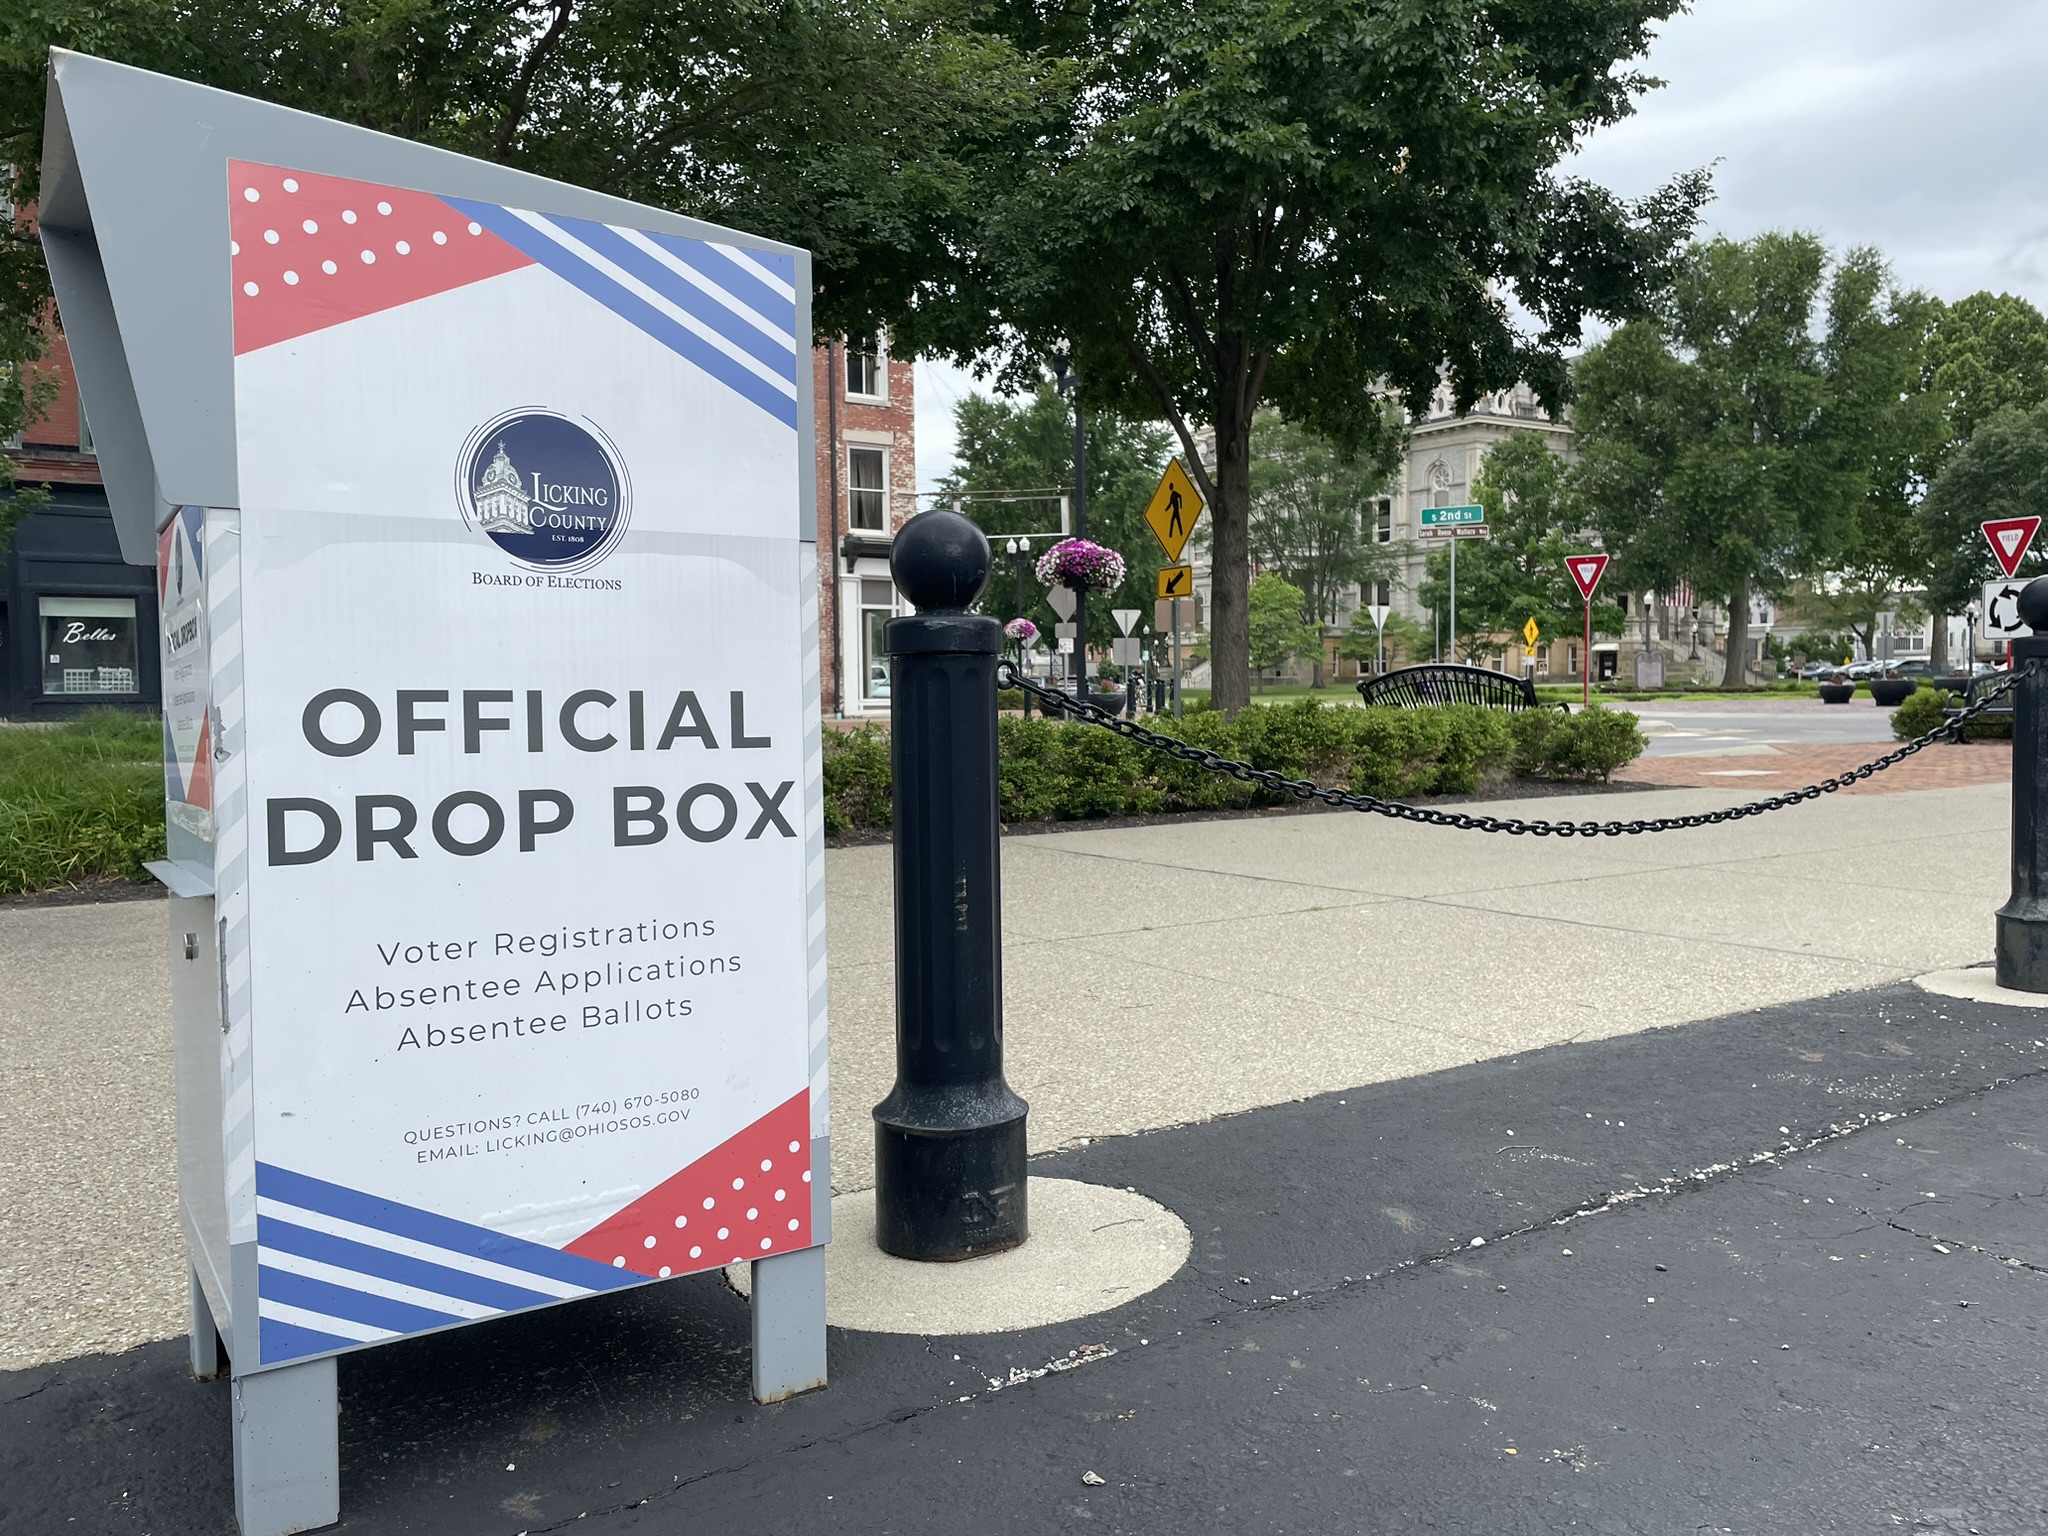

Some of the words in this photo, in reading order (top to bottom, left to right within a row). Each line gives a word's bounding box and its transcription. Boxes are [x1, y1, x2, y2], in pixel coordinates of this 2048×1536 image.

[530, 471, 608, 511] LICKING
[529, 506, 608, 532] COUNTY
[551, 534, 567, 542] EST.
[567, 535, 585, 543] 1808
[1440, 510, 1461, 521] 2nd
[1463, 511, 1472, 520] St
[2002, 534, 2019, 542] YIELD
[471, 571, 522, 587] BOARD
[525, 575, 544, 588] OF
[547, 575, 622, 591] ELECTIONS
[301, 687, 772, 758] OFFICIAL
[266, 788, 575, 868] DROP
[612, 780, 798, 848] BOX
[376, 940, 478, 966] Voter
[494, 918, 715, 957] Registrations
[344, 978, 521, 1014] Absentee
[534, 954, 742, 996] Applications
[396, 1014, 567, 1052] Absentee
[582, 998, 693, 1029] Ballots
[403, 1114, 522, 1147] QUESTIONS?
[526, 1108, 571, 1125] CALL
[575, 1099, 617, 1120] (740)
[623, 1087, 700, 1110] 670-5080
[417, 1144, 479, 1164] EMAIL:
[486, 1108, 692, 1153] LICKING@OHIOSOS.GOV
